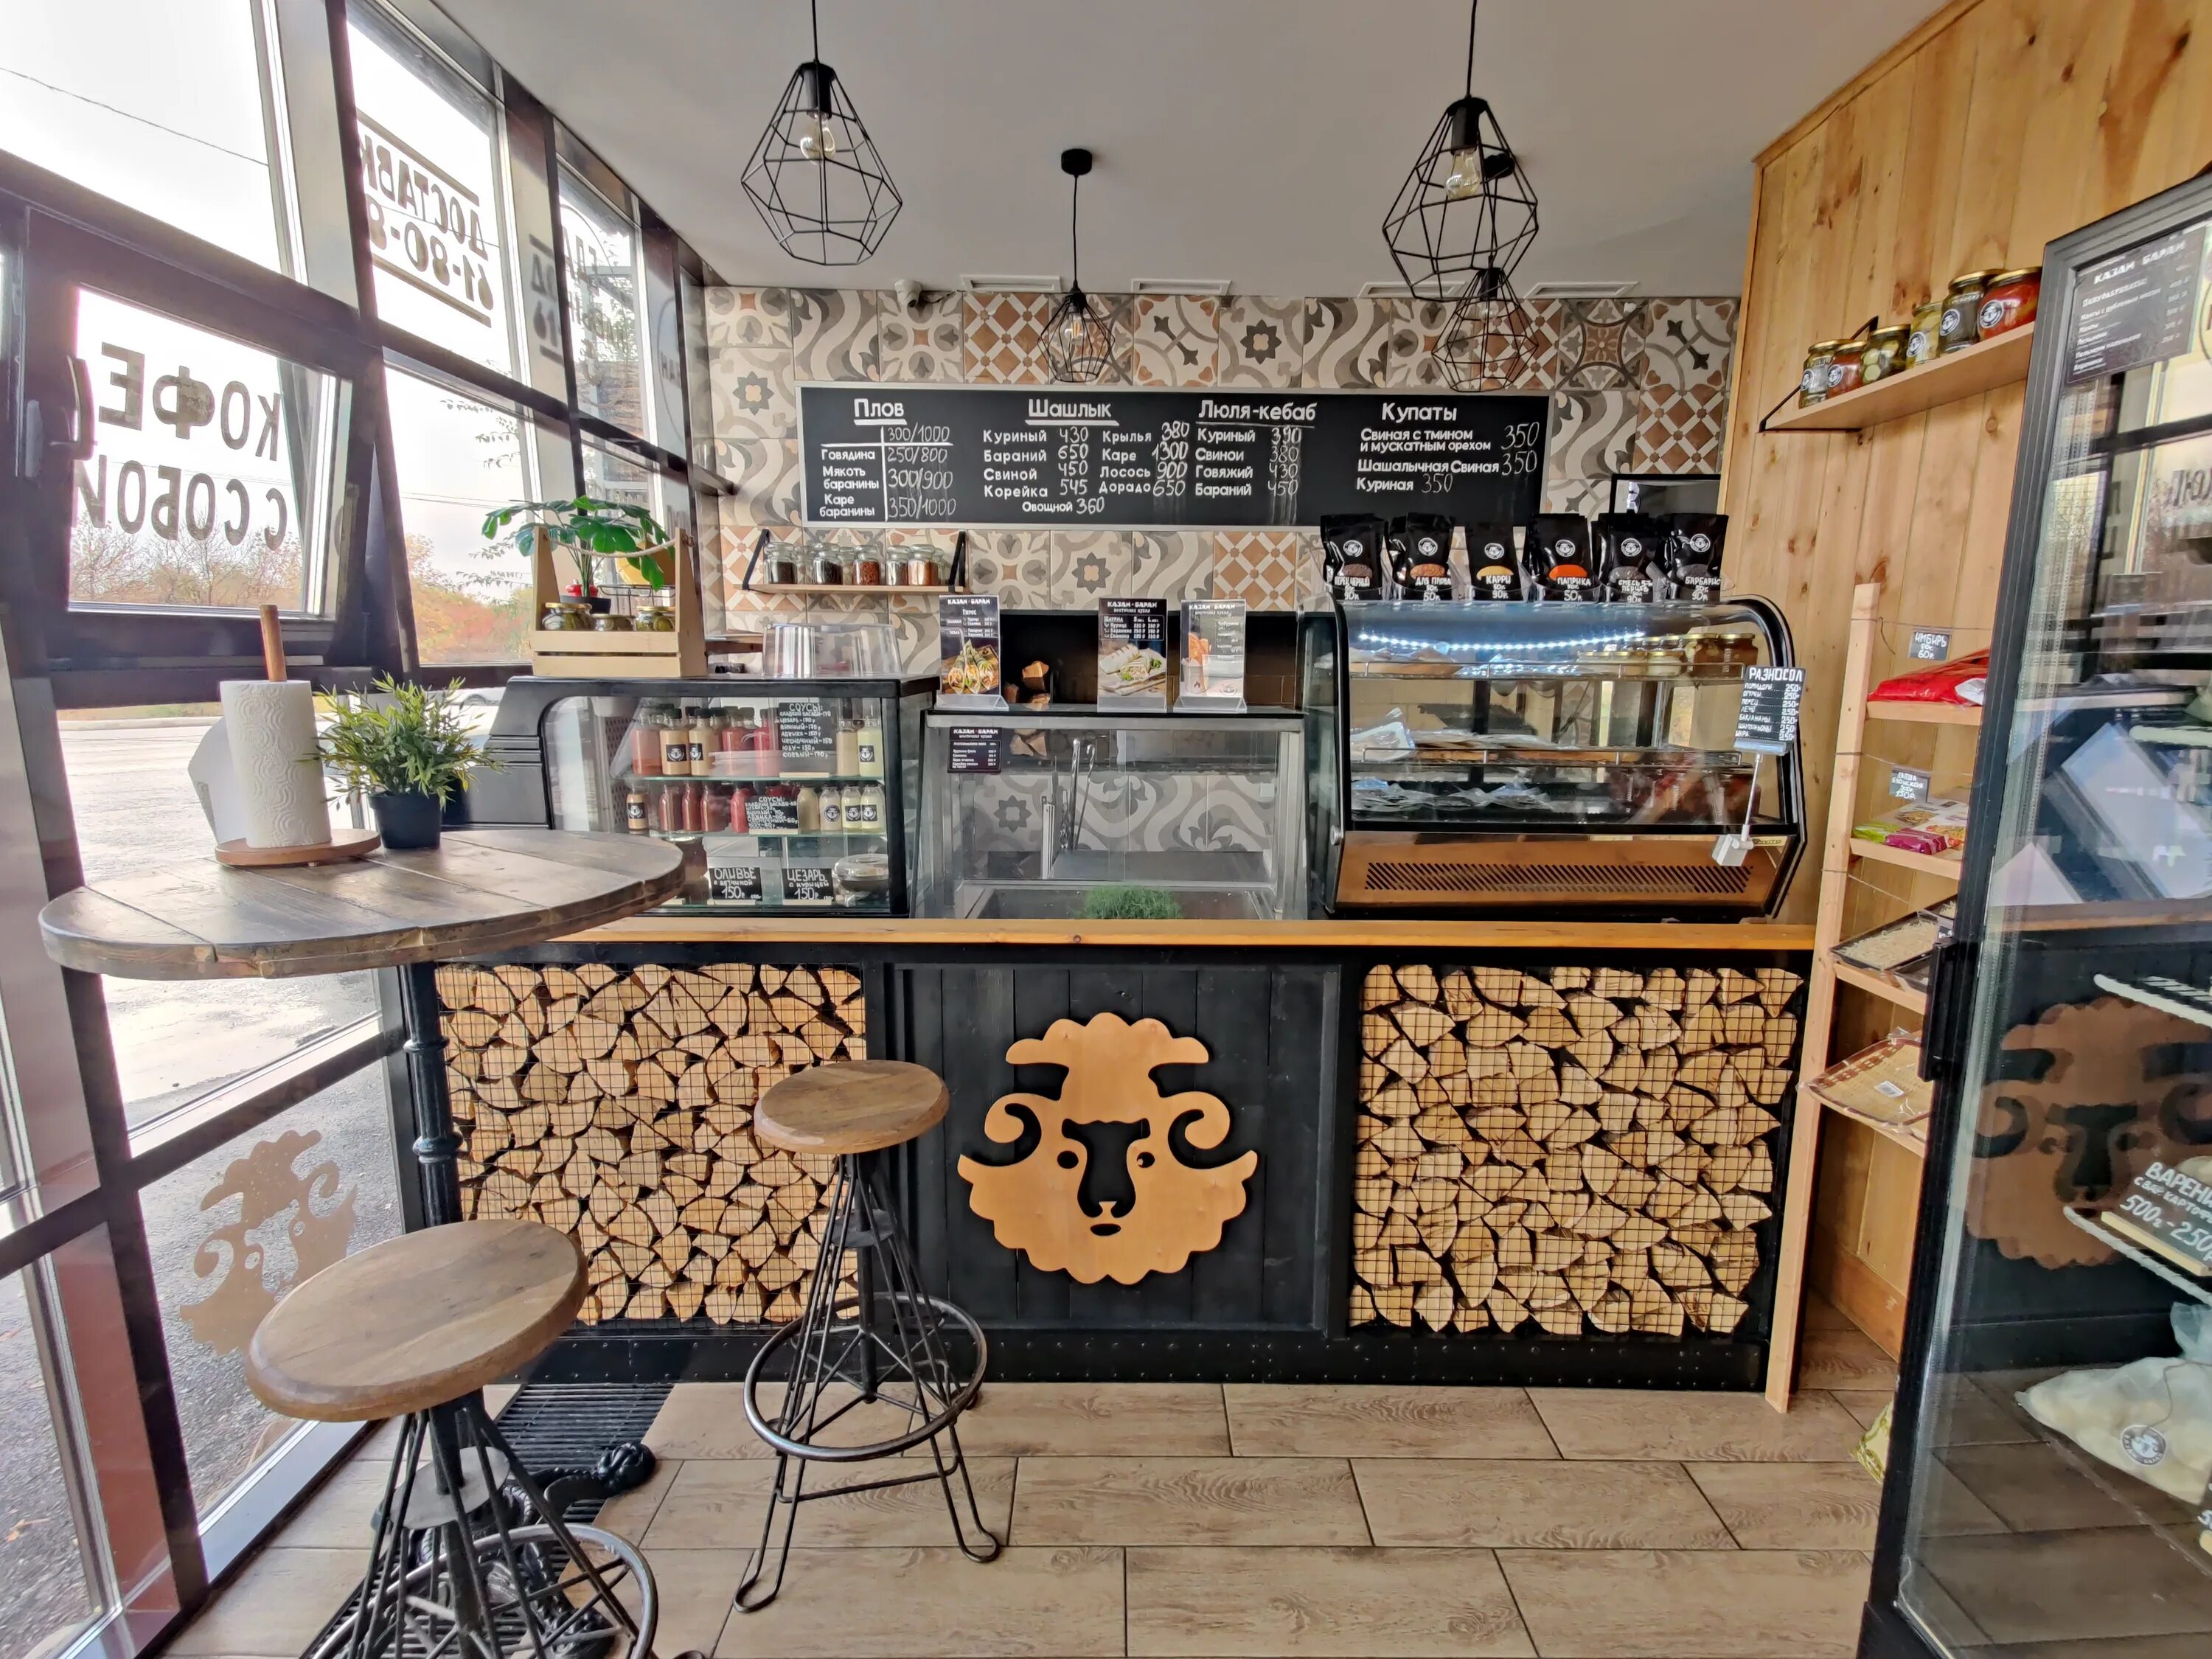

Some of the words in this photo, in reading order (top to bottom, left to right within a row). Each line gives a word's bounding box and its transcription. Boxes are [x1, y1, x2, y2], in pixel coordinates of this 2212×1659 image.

[854, 398, 905, 418] Плов
[1028, 398, 1113, 418] Шашлык
[1198, 399, 1318, 421] Люля-кебаб
[1382, 403, 1457, 423] Купаты
[982, 428, 1048, 443] Куриный
[1058, 426, 1090, 442] 430
[1102, 430, 1152, 445] Крылья
[1161, 420, 1190, 441] 380
[1197, 428, 1256, 445] Куриный
[1360, 428, 1410, 442] Свиная
[1413, 430, 1422, 440] с
[1424, 429, 1473, 440] тмином
[1500, 421, 1540, 451] 350
[821, 448, 876, 462] Говядина
[983, 448, 1048, 464] Бараний
[1057, 444, 1090, 460] 650
[1102, 448, 1137, 465] Каре
[1151, 441, 1189, 461] 1300
[1269, 445, 1299, 463] 380
[1360, 442, 1368, 453] и
[1371, 441, 1446, 454] мускатным
[1448, 441, 1491, 453] орехом
[822, 465, 866, 478] Мякоть
[983, 467, 1038, 481] Свиной
[1058, 461, 1089, 477] 450
[1099, 465, 1151, 479] Лосось
[1156, 461, 1188, 479] 900
[1195, 465, 1253, 479] Говяжий
[1269, 462, 1298, 479] 430
[1357, 459, 1449, 473] Шашалычная
[1450, 459, 1499, 473] Свиная
[1501, 450, 1537, 476] 350
[823, 477, 880, 491] баранины
[984, 484, 1048, 498] Корейка
[1059, 479, 1089, 496] 545
[1099, 481, 1151, 495] Дорадо
[1152, 479, 1186, 497] 650
[1195, 482, 1252, 498] Бараний
[1267, 479, 1298, 498] 450
[1356, 476, 1413, 493] Куриная
[1422, 473, 1453, 493] 350
[824, 493, 855, 507] Каре
[1021, 500, 1074, 514] Овощной
[1076, 496, 1105, 514] 360
[819, 504, 875, 518] баранины
[1486, 575, 1511, 585] КАРРИ
[1557, 577, 1591, 586] ПАПРИКА
[1685, 576, 1721, 585] БАРБАРИС
[1915, 632, 1947, 647] ИМБИРЬ
[1749, 667, 1803, 682] РАЗНОСОЛ
[714, 867, 757, 880] ОЛИВЬЕ
[787, 869, 826, 883] ЦЕЗАРЬ
